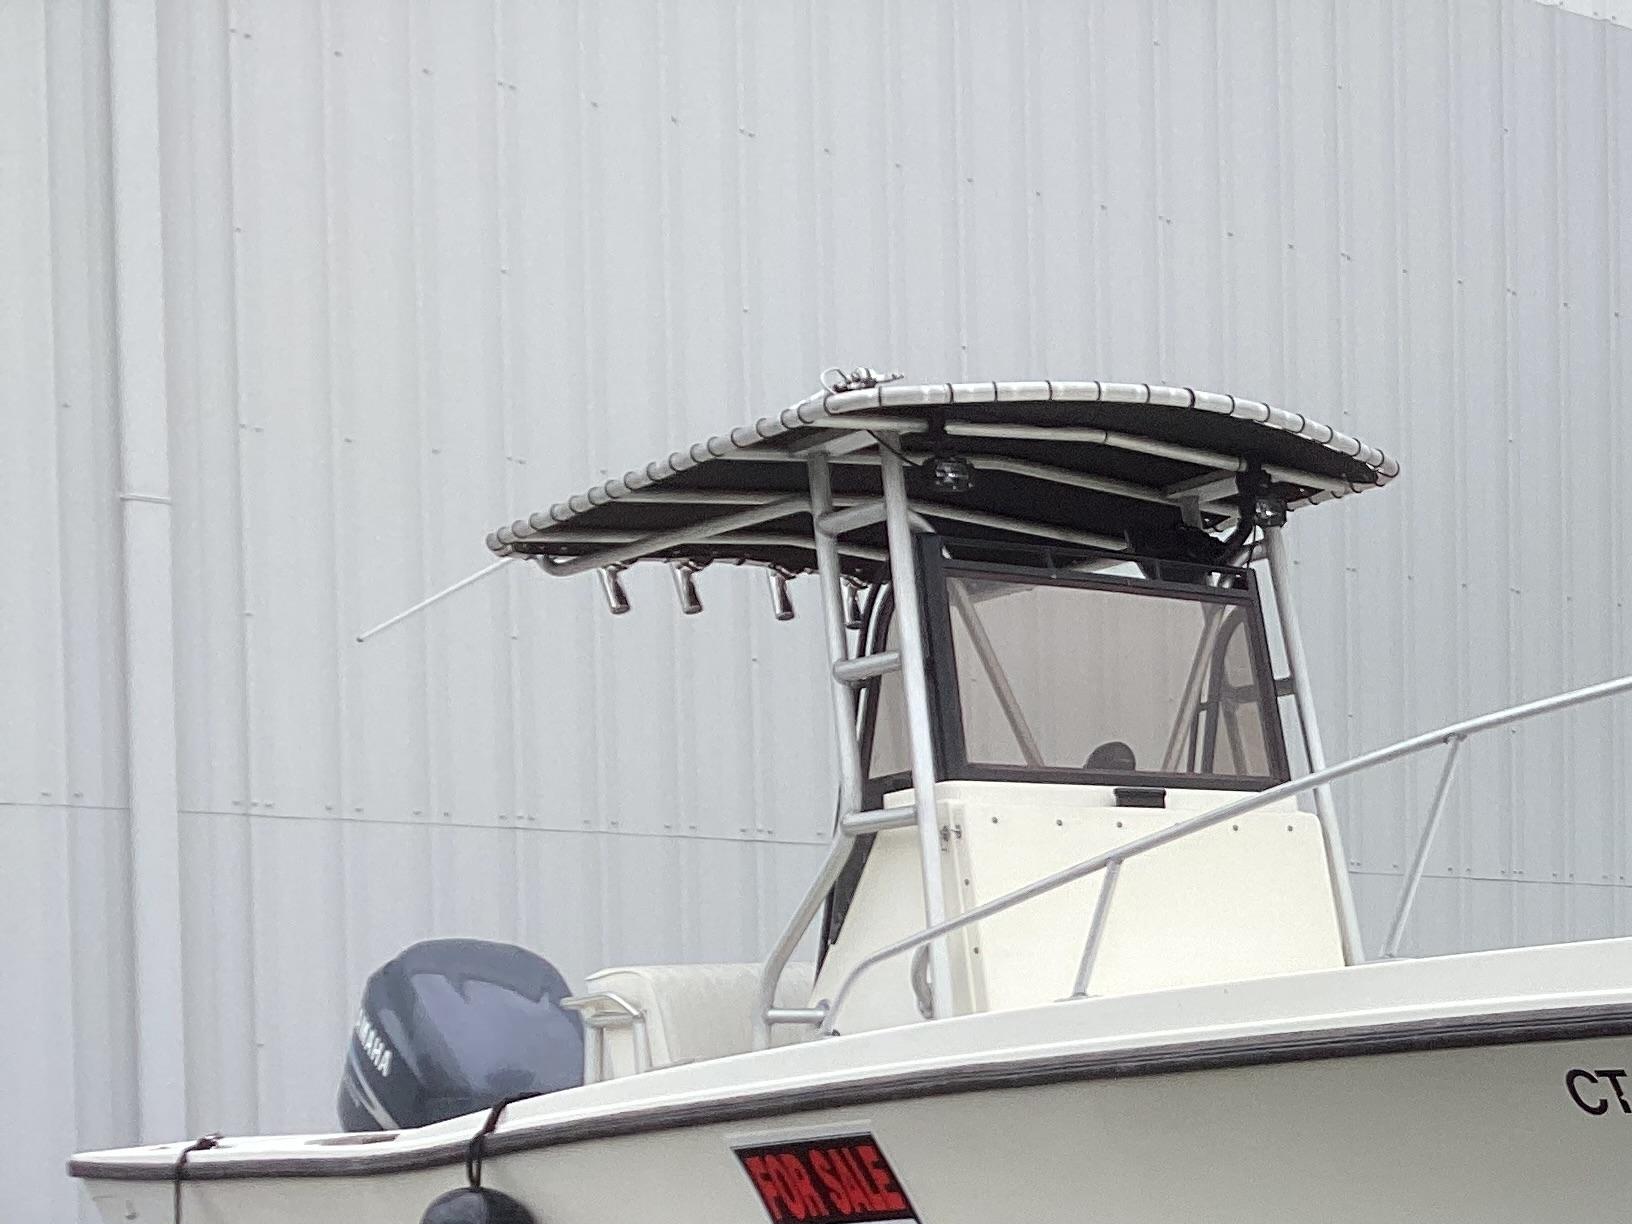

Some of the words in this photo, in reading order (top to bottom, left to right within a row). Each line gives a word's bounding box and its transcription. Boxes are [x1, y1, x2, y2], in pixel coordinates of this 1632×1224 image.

[1565, 1068, 1632, 1116] CT
[744, 1152, 830, 1222] FOR
[808, 1143, 907, 1216] SALE
